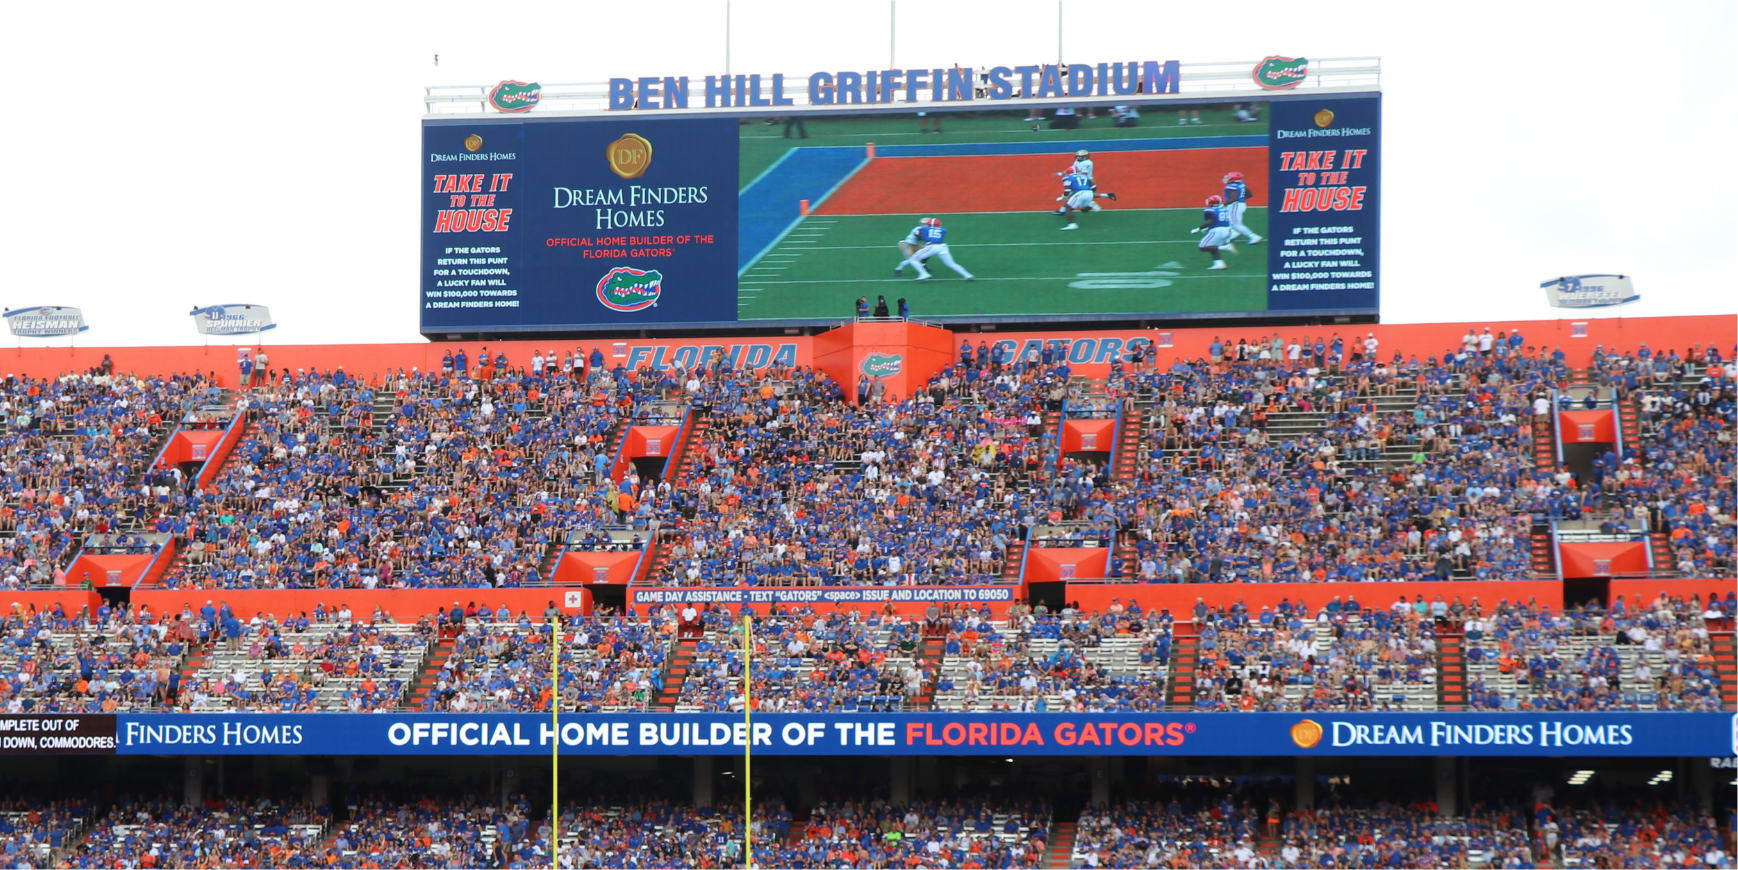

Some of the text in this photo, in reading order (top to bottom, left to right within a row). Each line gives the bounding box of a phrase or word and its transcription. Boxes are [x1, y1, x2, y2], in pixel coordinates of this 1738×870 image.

[609, 60, 1180, 110] BEN HILL GRIFFIN STADIUM
[1277, 128, 1371, 139] DREAM FINDERS HOMES
[430, 152, 516, 162] DREAM FINDERS HOMES
[617, 149, 642, 164] DF
[1279, 149, 1368, 171] TAKE IT
[433, 173, 513, 193] TAKE IT
[1076, 176, 1088, 186] 17
[1298, 172, 1349, 186] TO THE
[450, 194, 496, 207] TO THE
[554, 186, 708, 208] DREAM FINDERS
[1279, 186, 1367, 213] HOUSE
[433, 208, 512, 233] HOUSE
[596, 209, 665, 230] HOMES
[928, 229, 942, 238] 15
[546, 235, 714, 247] OFFICIAL HOME BUILDER OF THE
[583, 249, 627, 258] FLORIDA
[1291, 272, 1329, 280] $100,000
[1567, 283, 1574, 291] 7
[443, 290, 478, 298] $100,000
[12, 320, 80, 329] HEISMAN
[626, 344, 797, 371] FLORIDA
[637, 591, 663, 602] GAME
[665, 591, 682, 602] DAY
[686, 591, 742, 602] ASSISTANCE
[750, 591, 773, 601] TEXT
[824, 590, 860, 601] <space>
[863, 590, 889, 600] ISSUE
[892, 590, 912, 600] AND
[914, 589, 961, 600] LOCATION
[964, 589, 976, 600] TO
[979, 589, 1008, 600] 69050
[42, 720, 64, 731] OUT
[65, 720, 80, 731] OF
[125, 722, 216, 745] FINDERS
[222, 722, 303, 745] HOMES
[387, 723, 530, 746] OFFICIAL
[540, 723, 629, 746] HOME
[640, 723, 772, 746] BUILDER
[782, 723, 826, 746] OF
[835, 723, 895, 746] THE
[906, 723, 1044, 746] FLORIDA
[1332, 721, 1632, 747] DREAM FINDERS HOMES
[3, 737, 37, 749] DOWN,
[40, 737, 117, 748] COMMODORES.
[506, 769, 514, 777] D
